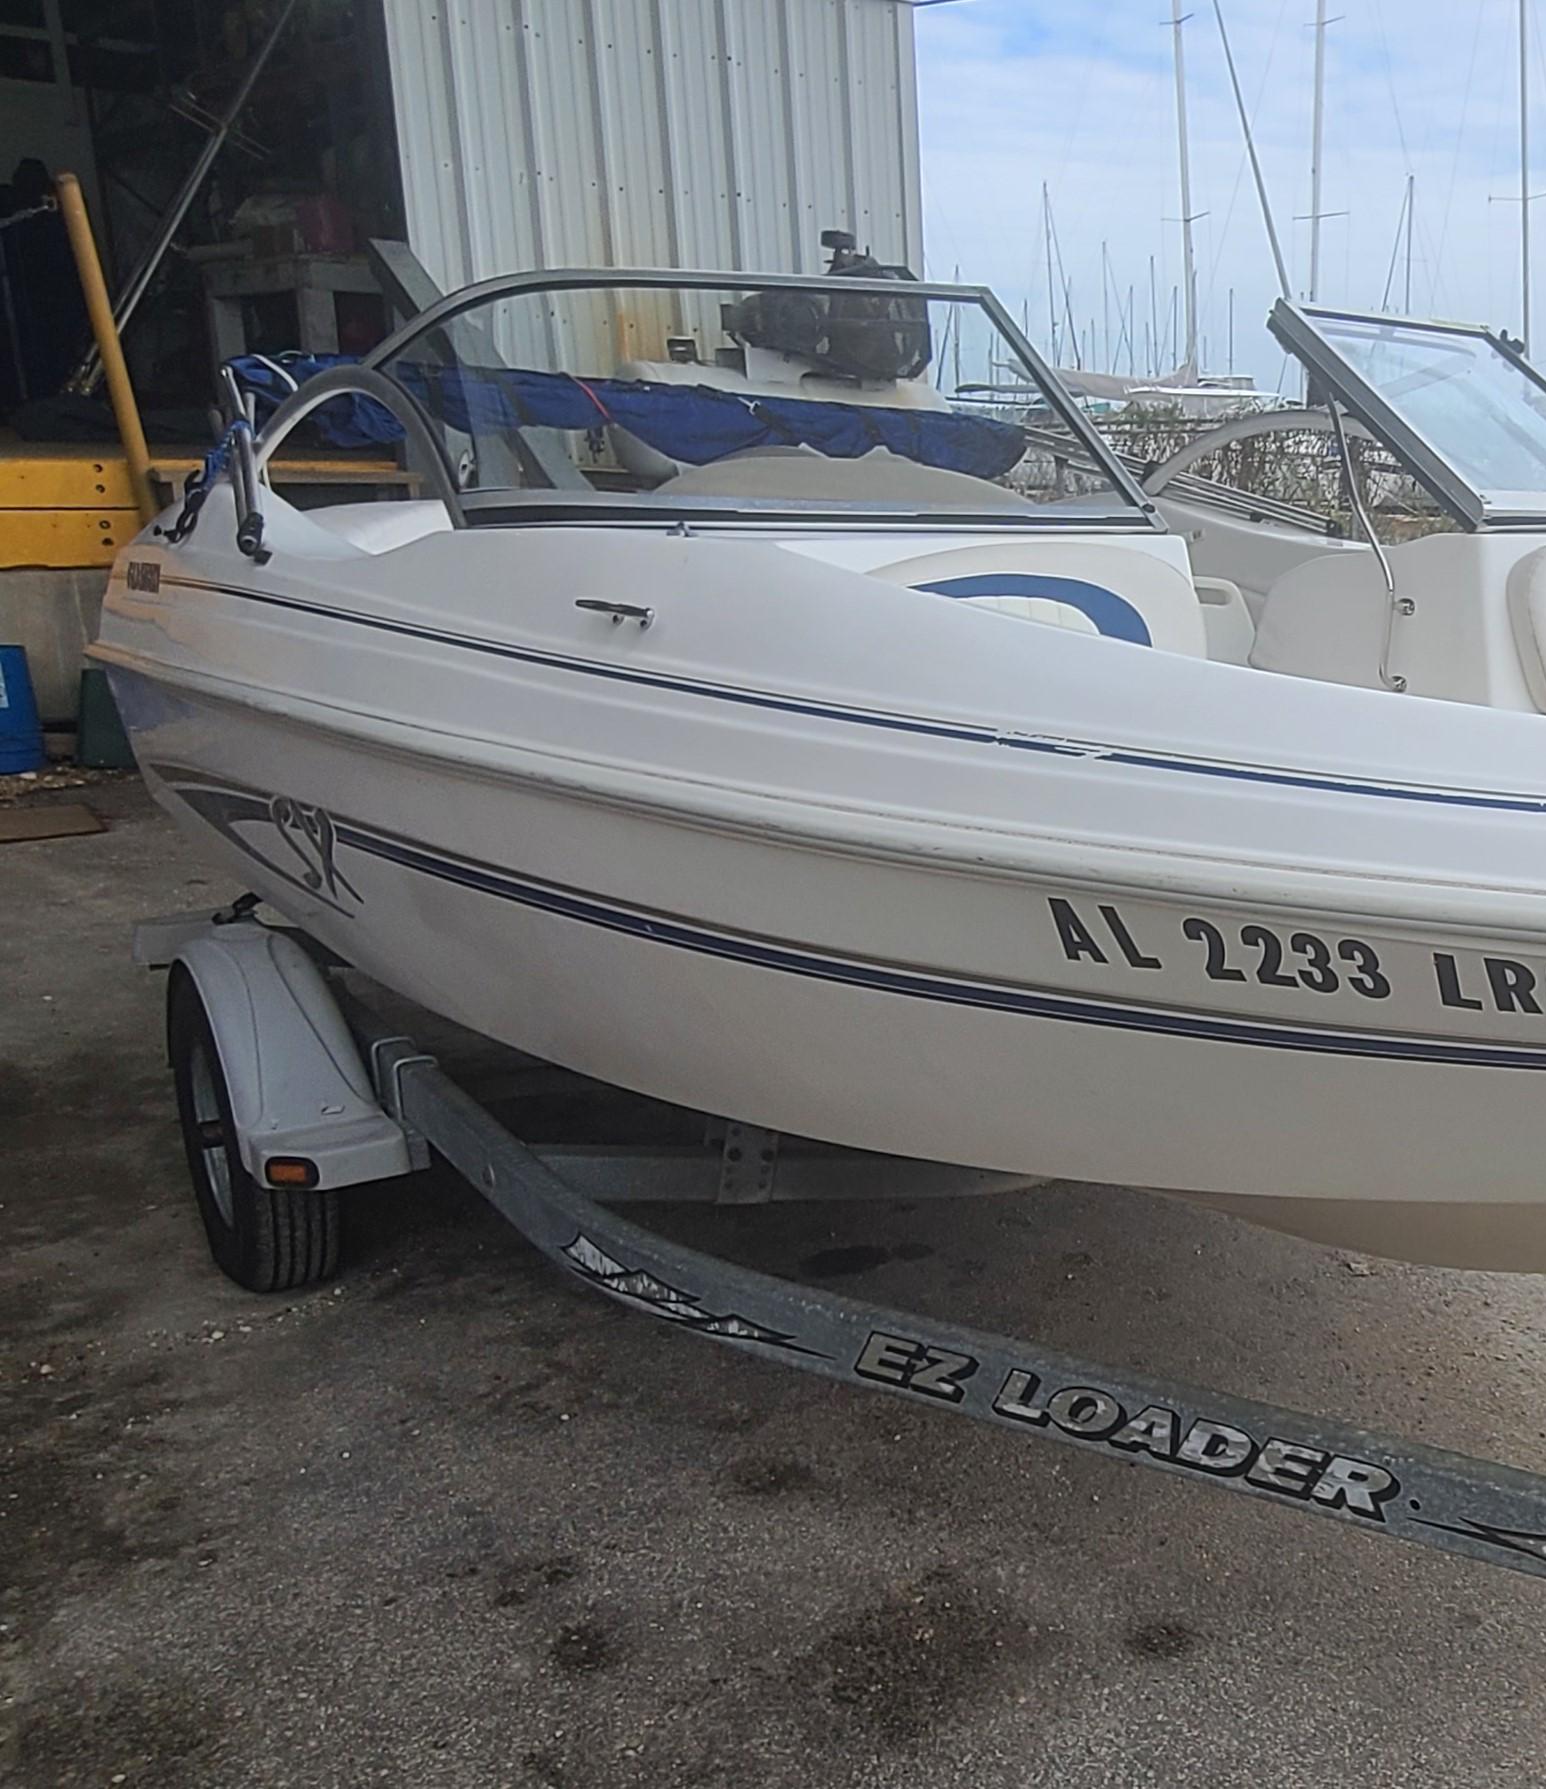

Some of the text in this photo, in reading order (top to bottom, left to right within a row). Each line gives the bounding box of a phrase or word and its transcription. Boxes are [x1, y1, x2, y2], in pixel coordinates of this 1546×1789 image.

[1047, 897, 1544, 1015] AL 2233 LR
[854, 1330, 1402, 1523] EZ LOADER
